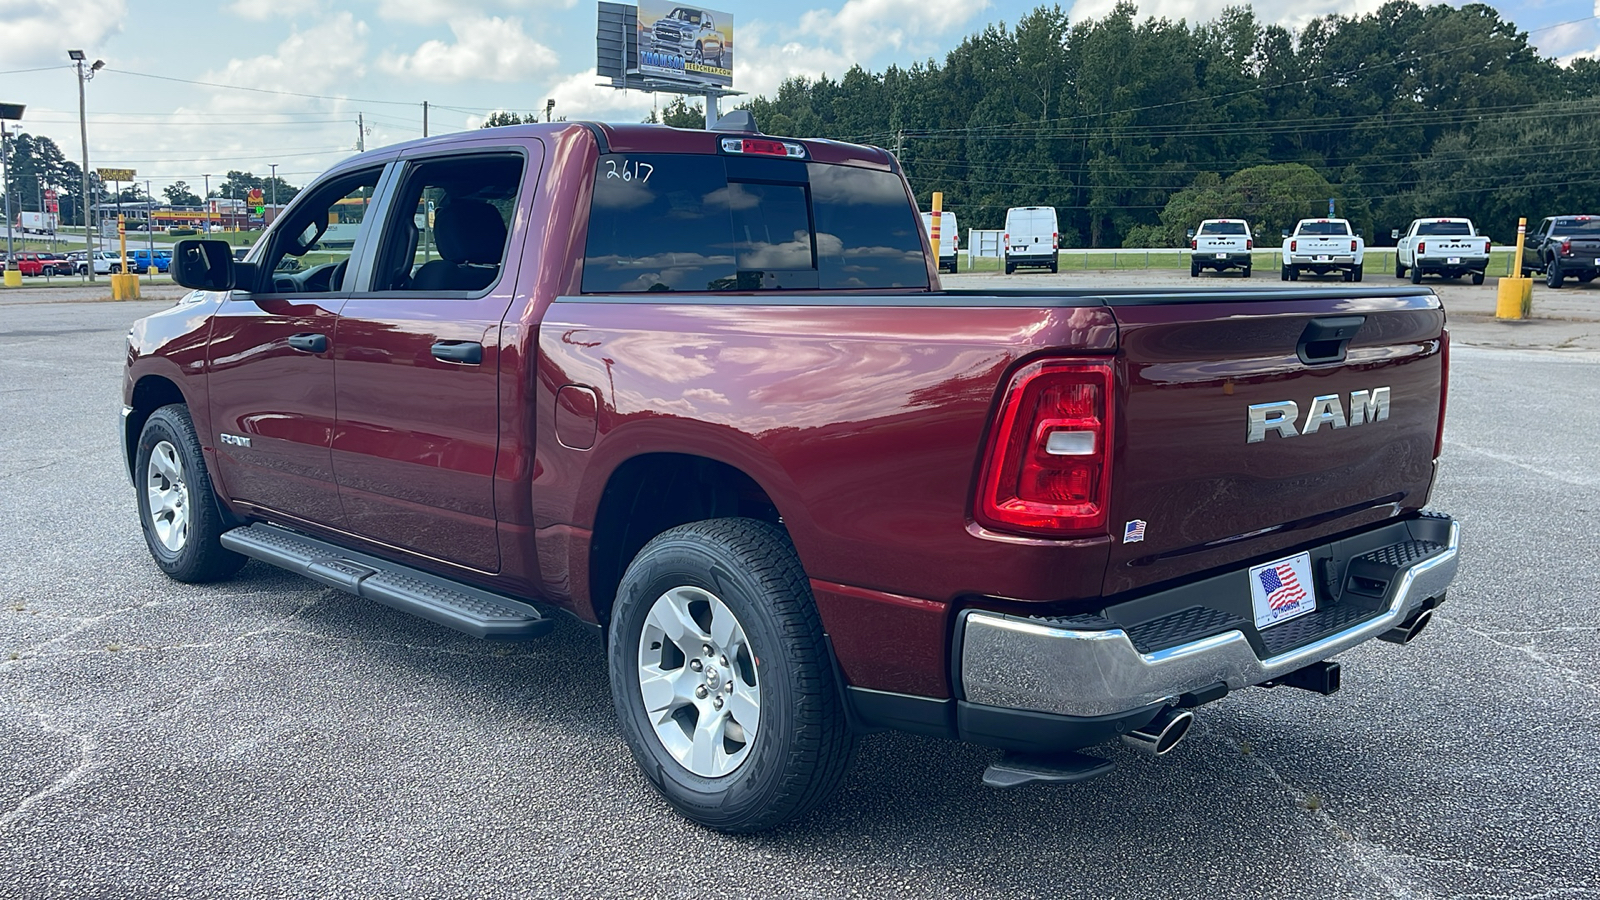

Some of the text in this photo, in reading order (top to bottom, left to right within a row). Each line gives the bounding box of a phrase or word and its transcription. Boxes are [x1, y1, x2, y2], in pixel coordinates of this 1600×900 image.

[641, 51, 685, 70] THOMSON
[685, 63, 731, 76] JEEPCHEAP.COM
[605, 159, 653, 183] 2617
[1246, 386, 1391, 444] RAM
[220, 432, 252, 448] RAM
[1278, 600, 1300, 614] THOMSON
